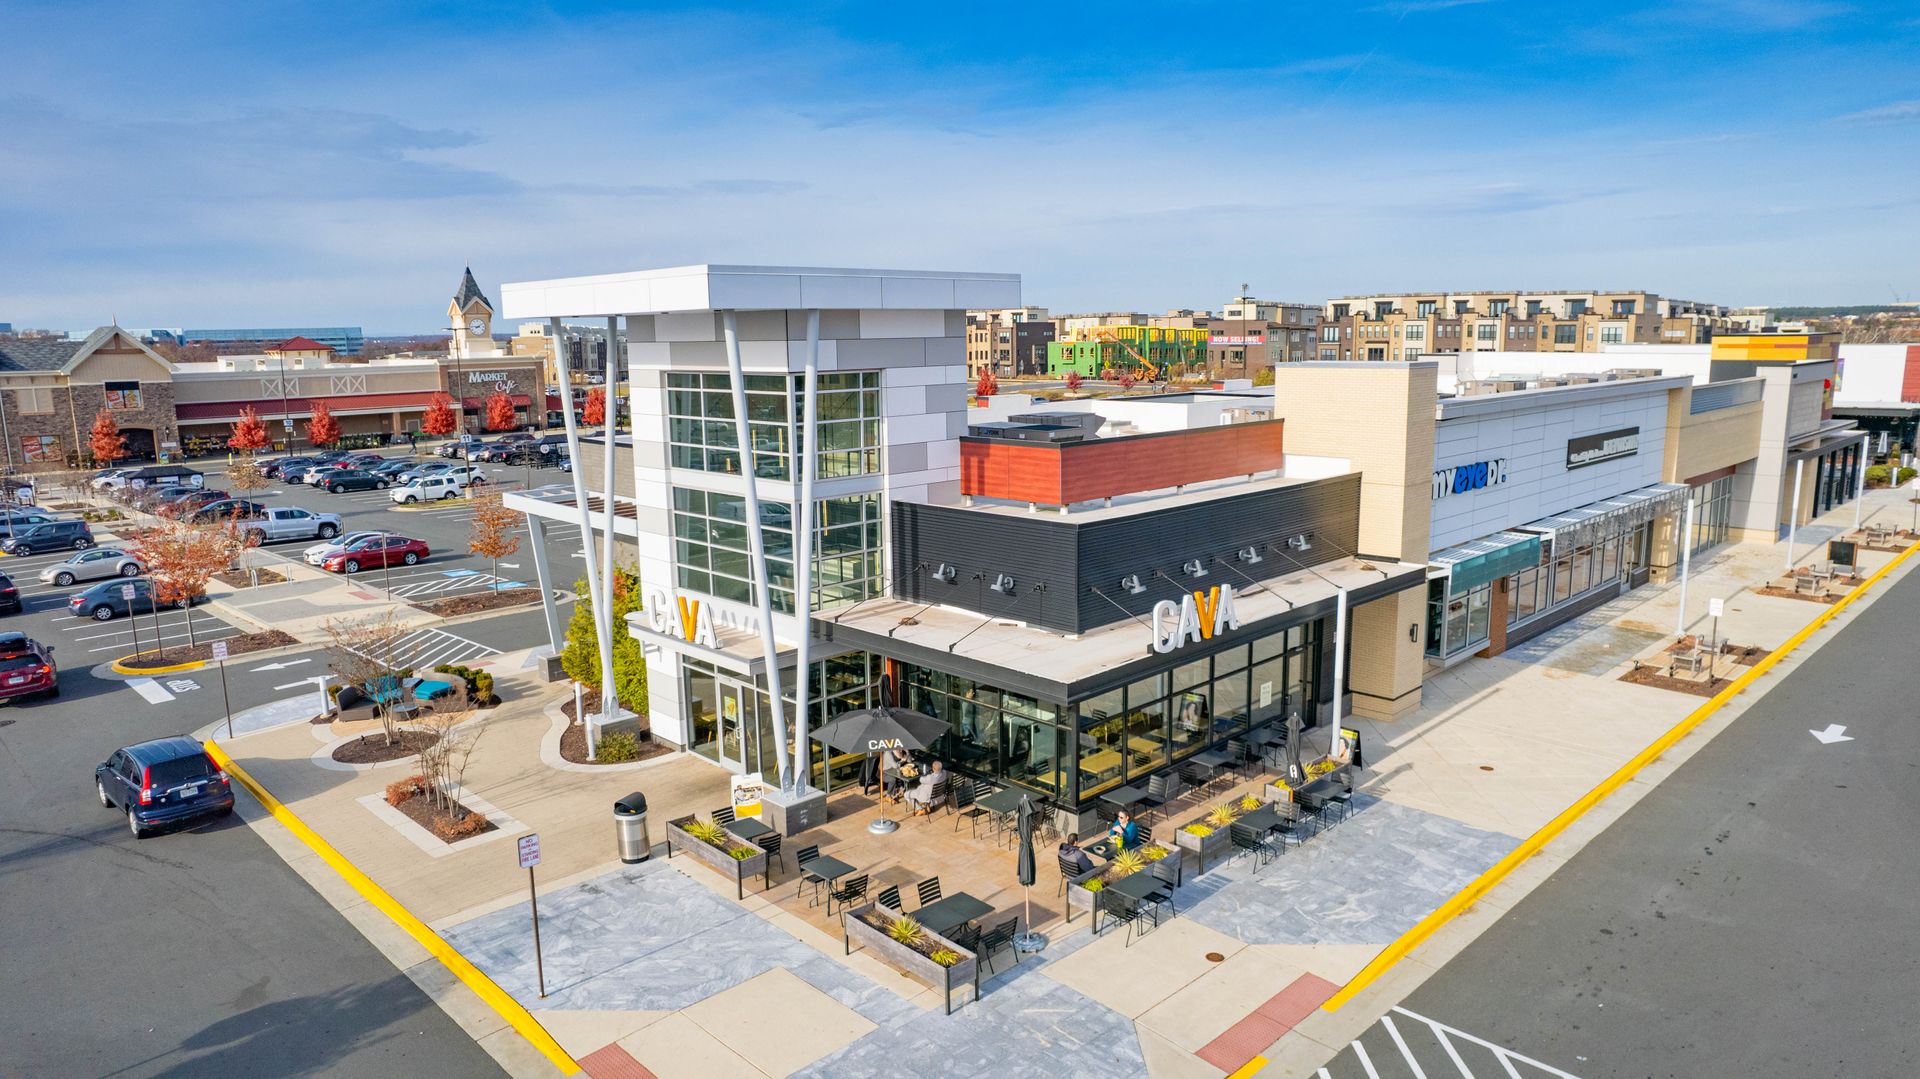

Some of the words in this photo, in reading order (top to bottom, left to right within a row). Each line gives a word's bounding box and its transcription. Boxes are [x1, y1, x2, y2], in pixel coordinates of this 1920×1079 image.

[469, 371, 508, 384] MARKET
[649, 590, 719, 649] CAVA
[1152, 583, 1239, 654] CAVA
[868, 738, 904, 750] CAVA
